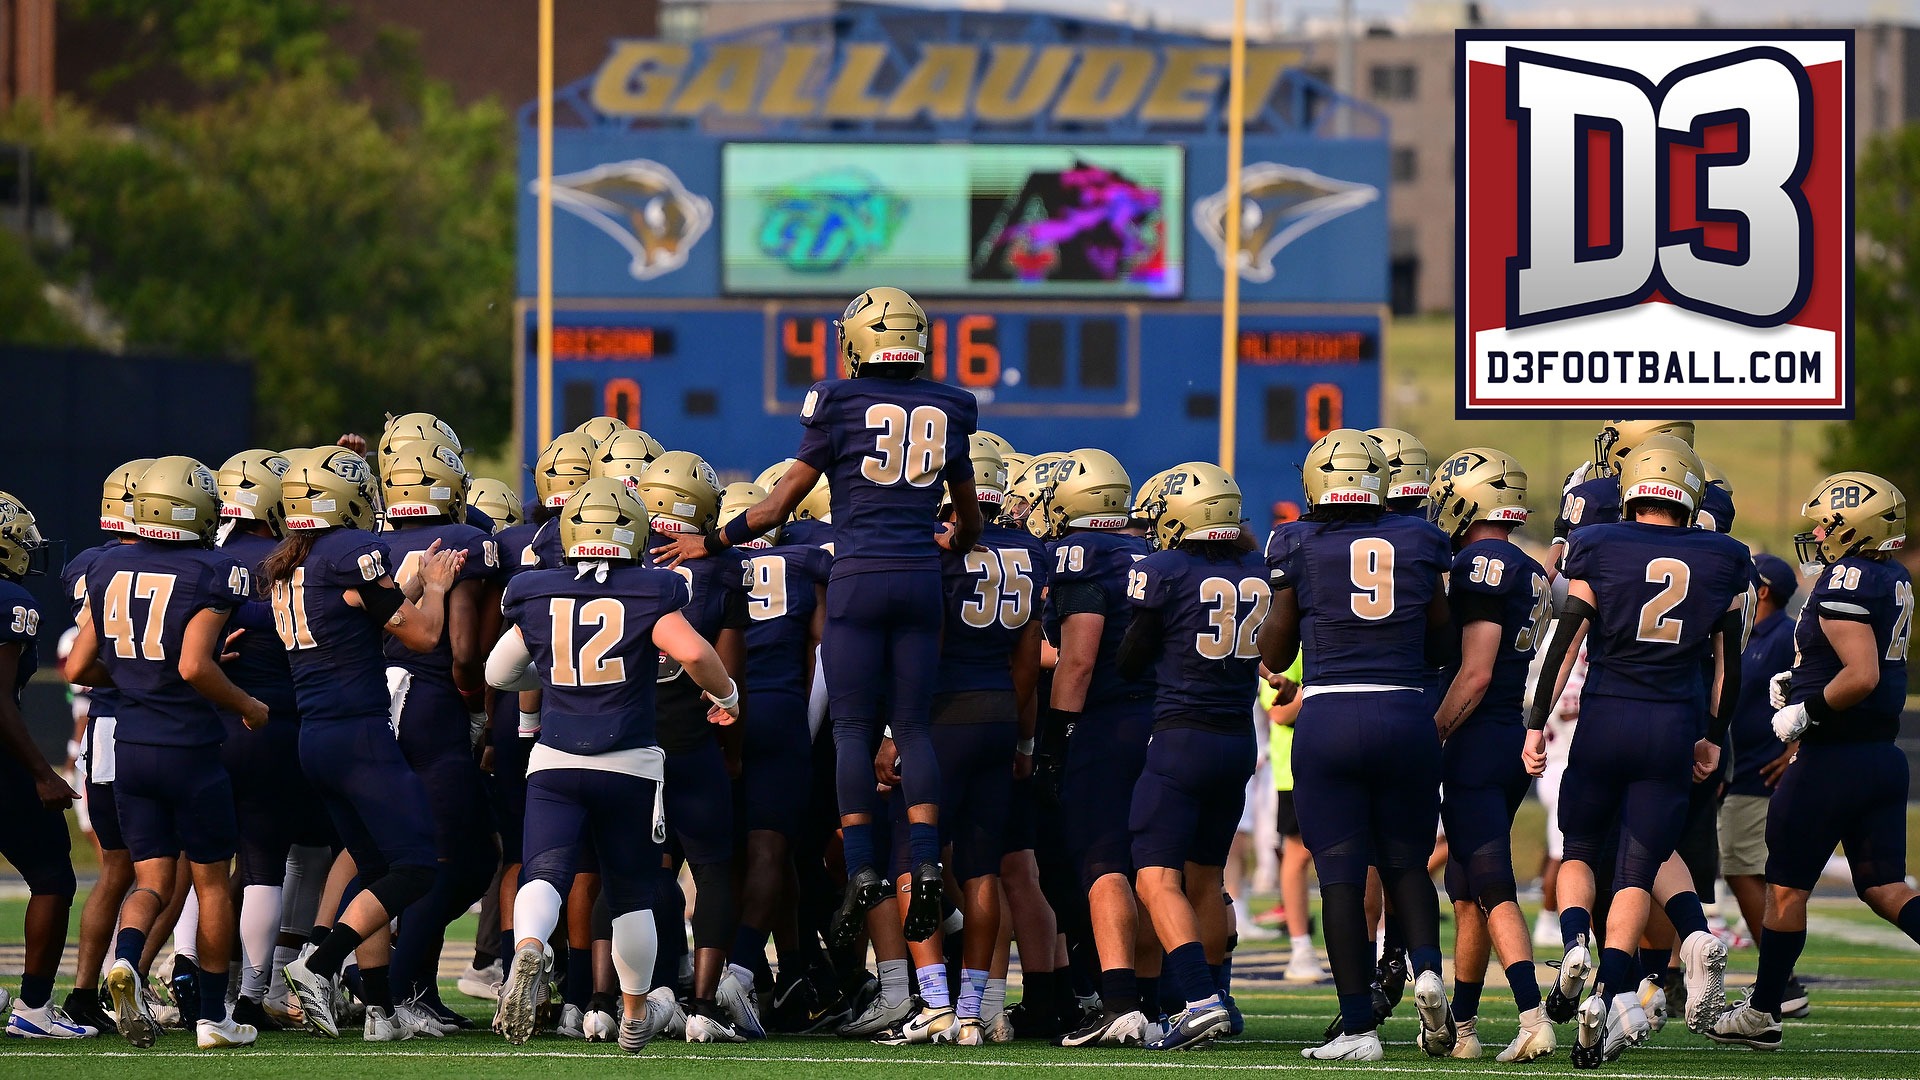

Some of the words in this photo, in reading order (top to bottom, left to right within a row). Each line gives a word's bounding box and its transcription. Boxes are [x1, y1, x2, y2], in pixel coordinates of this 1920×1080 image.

[591, 39, 1303, 120] GALLAUDET
[882, 351, 920, 362] Riddell
[860, 403, 948, 488] 38
[1159, 472, 1188, 496] 32
[1440, 455, 1469, 482] 36
[1330, 492, 1371, 503] Riddell
[1637, 485, 1683, 501] Riddell
[1830, 486, 1861, 511] 28
[391, 505, 428, 517] Riddell
[1089, 518, 1127, 528] Riddell
[139, 526, 181, 541] Riddell
[577, 545, 620, 557] Riddell
[1055, 545, 1085, 574] 79
[228, 565, 250, 597] 47
[1127, 568, 1148, 601] 32
[1349, 537, 1396, 621] 9
[1469, 555, 1505, 587] 36
[1827, 564, 1862, 591] 28
[960, 547, 1034, 630] 35
[1636, 557, 1691, 645] 2
[11, 605, 40, 636] 39
[103, 570, 178, 661] 47
[271, 566, 318, 651] 81
[1196, 576, 1272, 660] 32
[549, 597, 627, 687] 12
